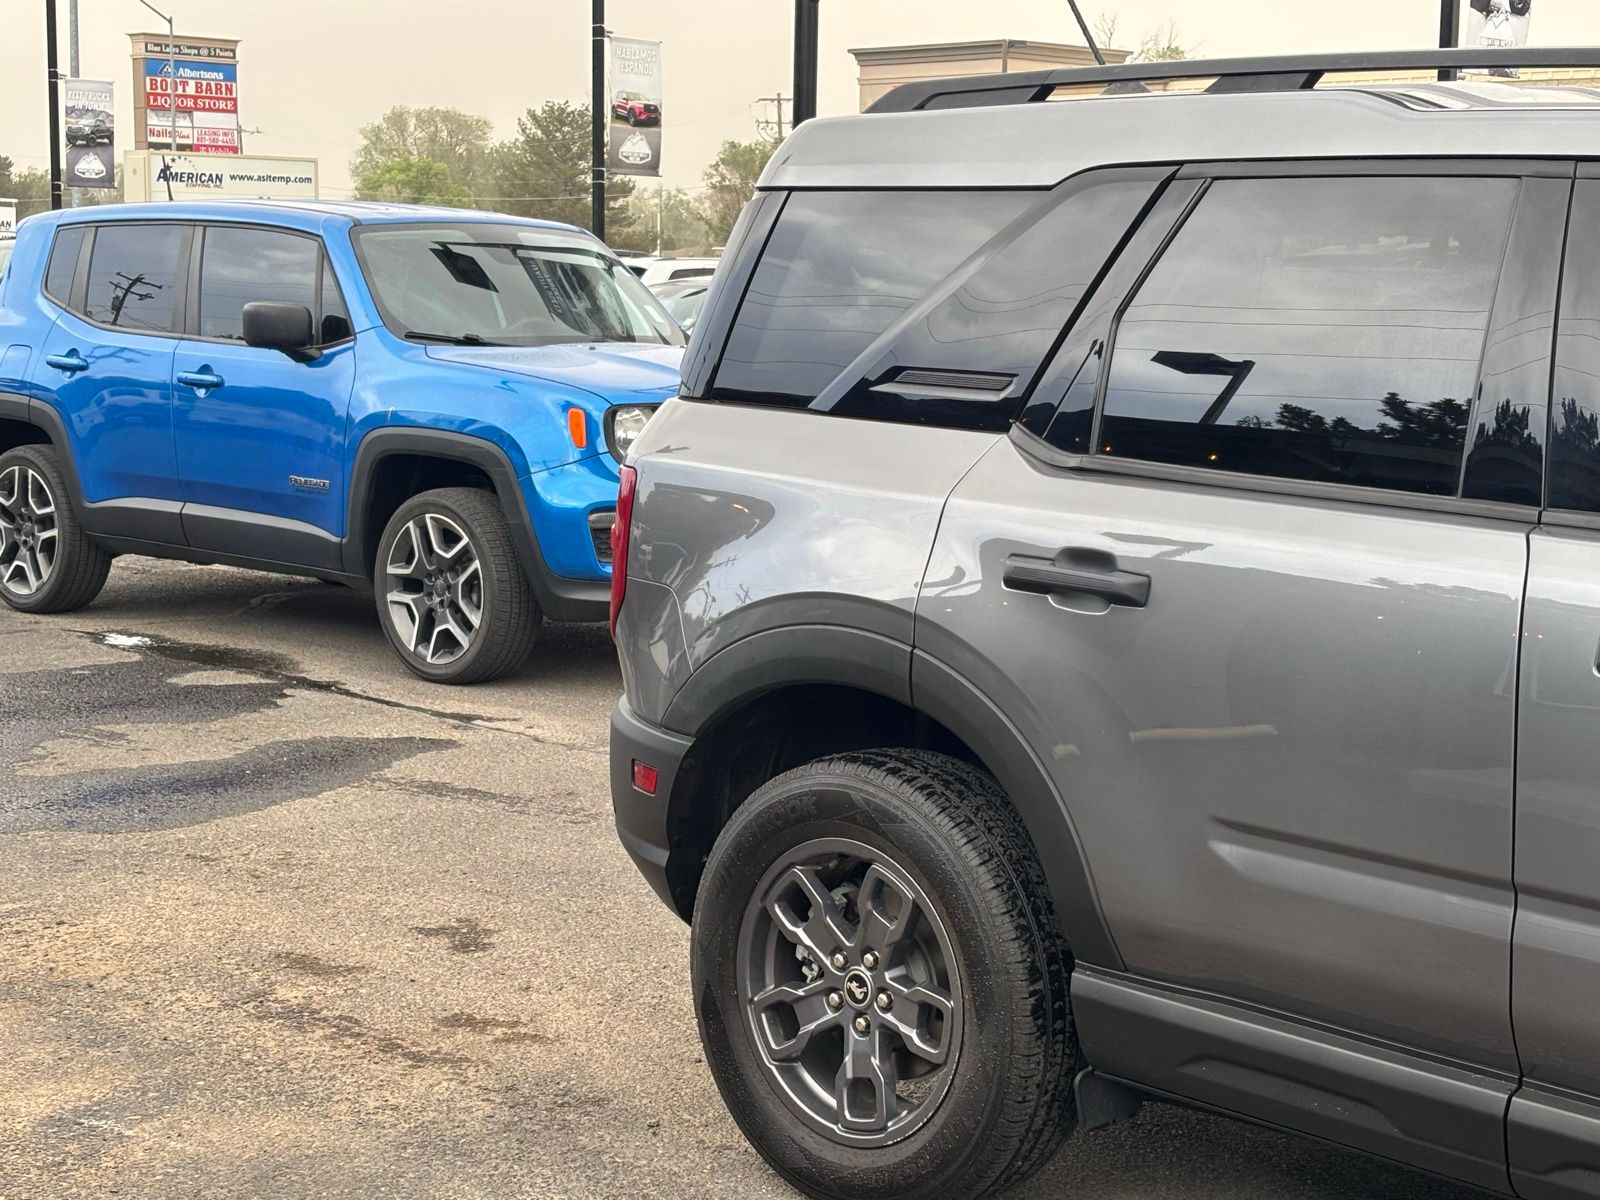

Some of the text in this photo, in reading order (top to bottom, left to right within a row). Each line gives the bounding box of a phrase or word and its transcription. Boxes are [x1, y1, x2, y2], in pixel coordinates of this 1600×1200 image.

[147, 43, 234, 57] Blue Laes Shops @ 5 Points
[620, 60, 653, 74] ESPAÑOL
[178, 67, 224, 80] Albertsons
[195, 81, 233, 96] BARN
[67, 90, 110, 101] BEST TRUCKS
[75, 100, 105, 110] IN TOWN
[197, 98, 235, 110] STORE
[149, 127, 190, 139] Nails Plus
[197, 128, 220, 137] LEASING
[156, 168, 312, 185] AMERICAN www.asitemp.com
